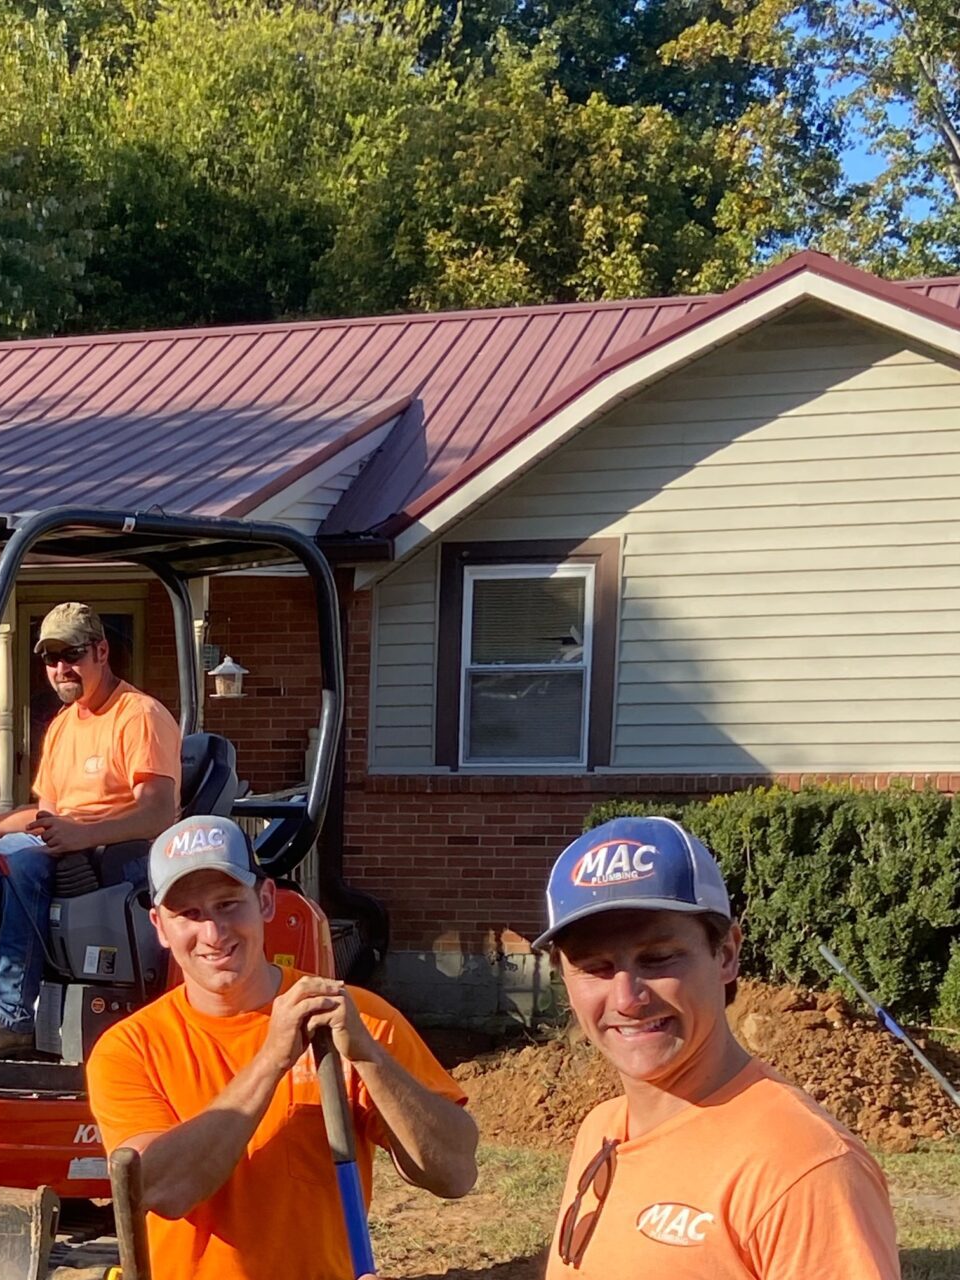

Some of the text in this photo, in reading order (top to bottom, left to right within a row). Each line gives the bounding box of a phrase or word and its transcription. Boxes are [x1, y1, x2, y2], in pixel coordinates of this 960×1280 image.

[169, 828, 223, 858] MAC
[574, 845, 657, 886] MAC
[591, 870, 638, 885] PLUMBING
[637, 1204, 714, 1241] MAC
